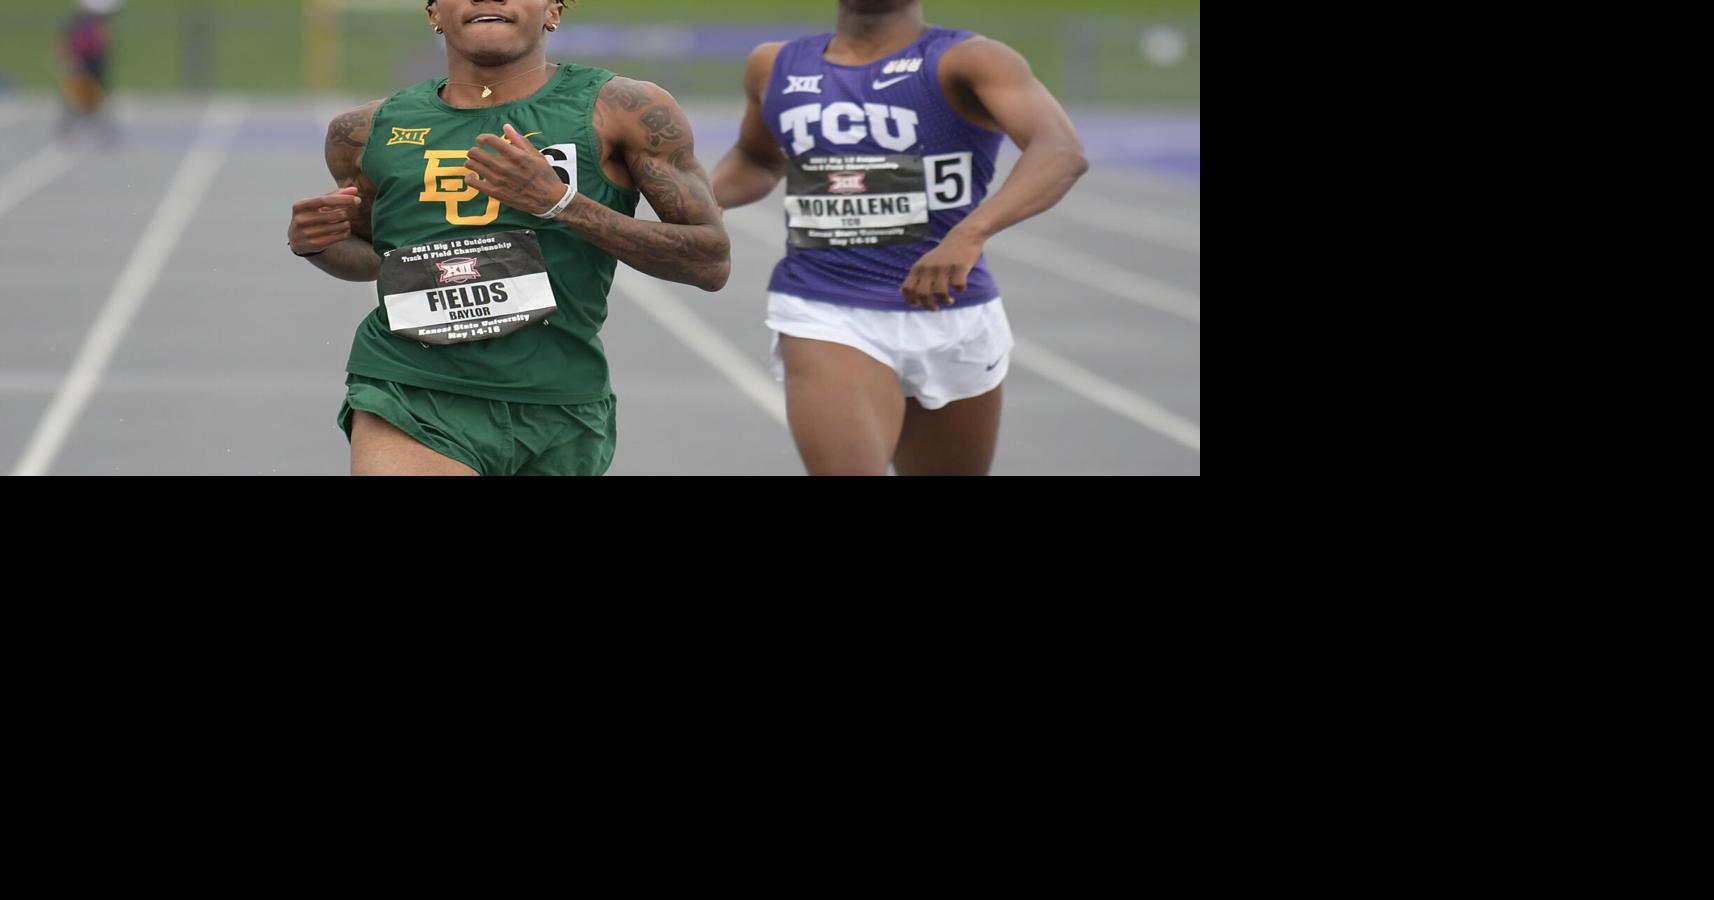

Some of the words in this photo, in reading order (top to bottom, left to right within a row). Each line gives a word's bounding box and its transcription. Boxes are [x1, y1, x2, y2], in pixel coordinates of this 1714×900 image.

[780, 101, 919, 156] TCU
[934, 157, 964, 204] 5
[798, 196, 911, 217] MOKALENG
[401, 255, 423, 263] Track
[430, 250, 452, 259] Field
[453, 241, 512, 255] Championship
[412, 245, 431, 253] 2021
[434, 243, 449, 251] Big
[451, 240, 462, 248] 12
[463, 237, 496, 246] Outdoor
[426, 282, 508, 312] FIELDS
[418, 325, 452, 336] Kansas
[453, 322, 479, 331] State
[481, 313, 530, 325] University
[449, 306, 491, 321] BAYLOR
[448, 331, 468, 339] May
